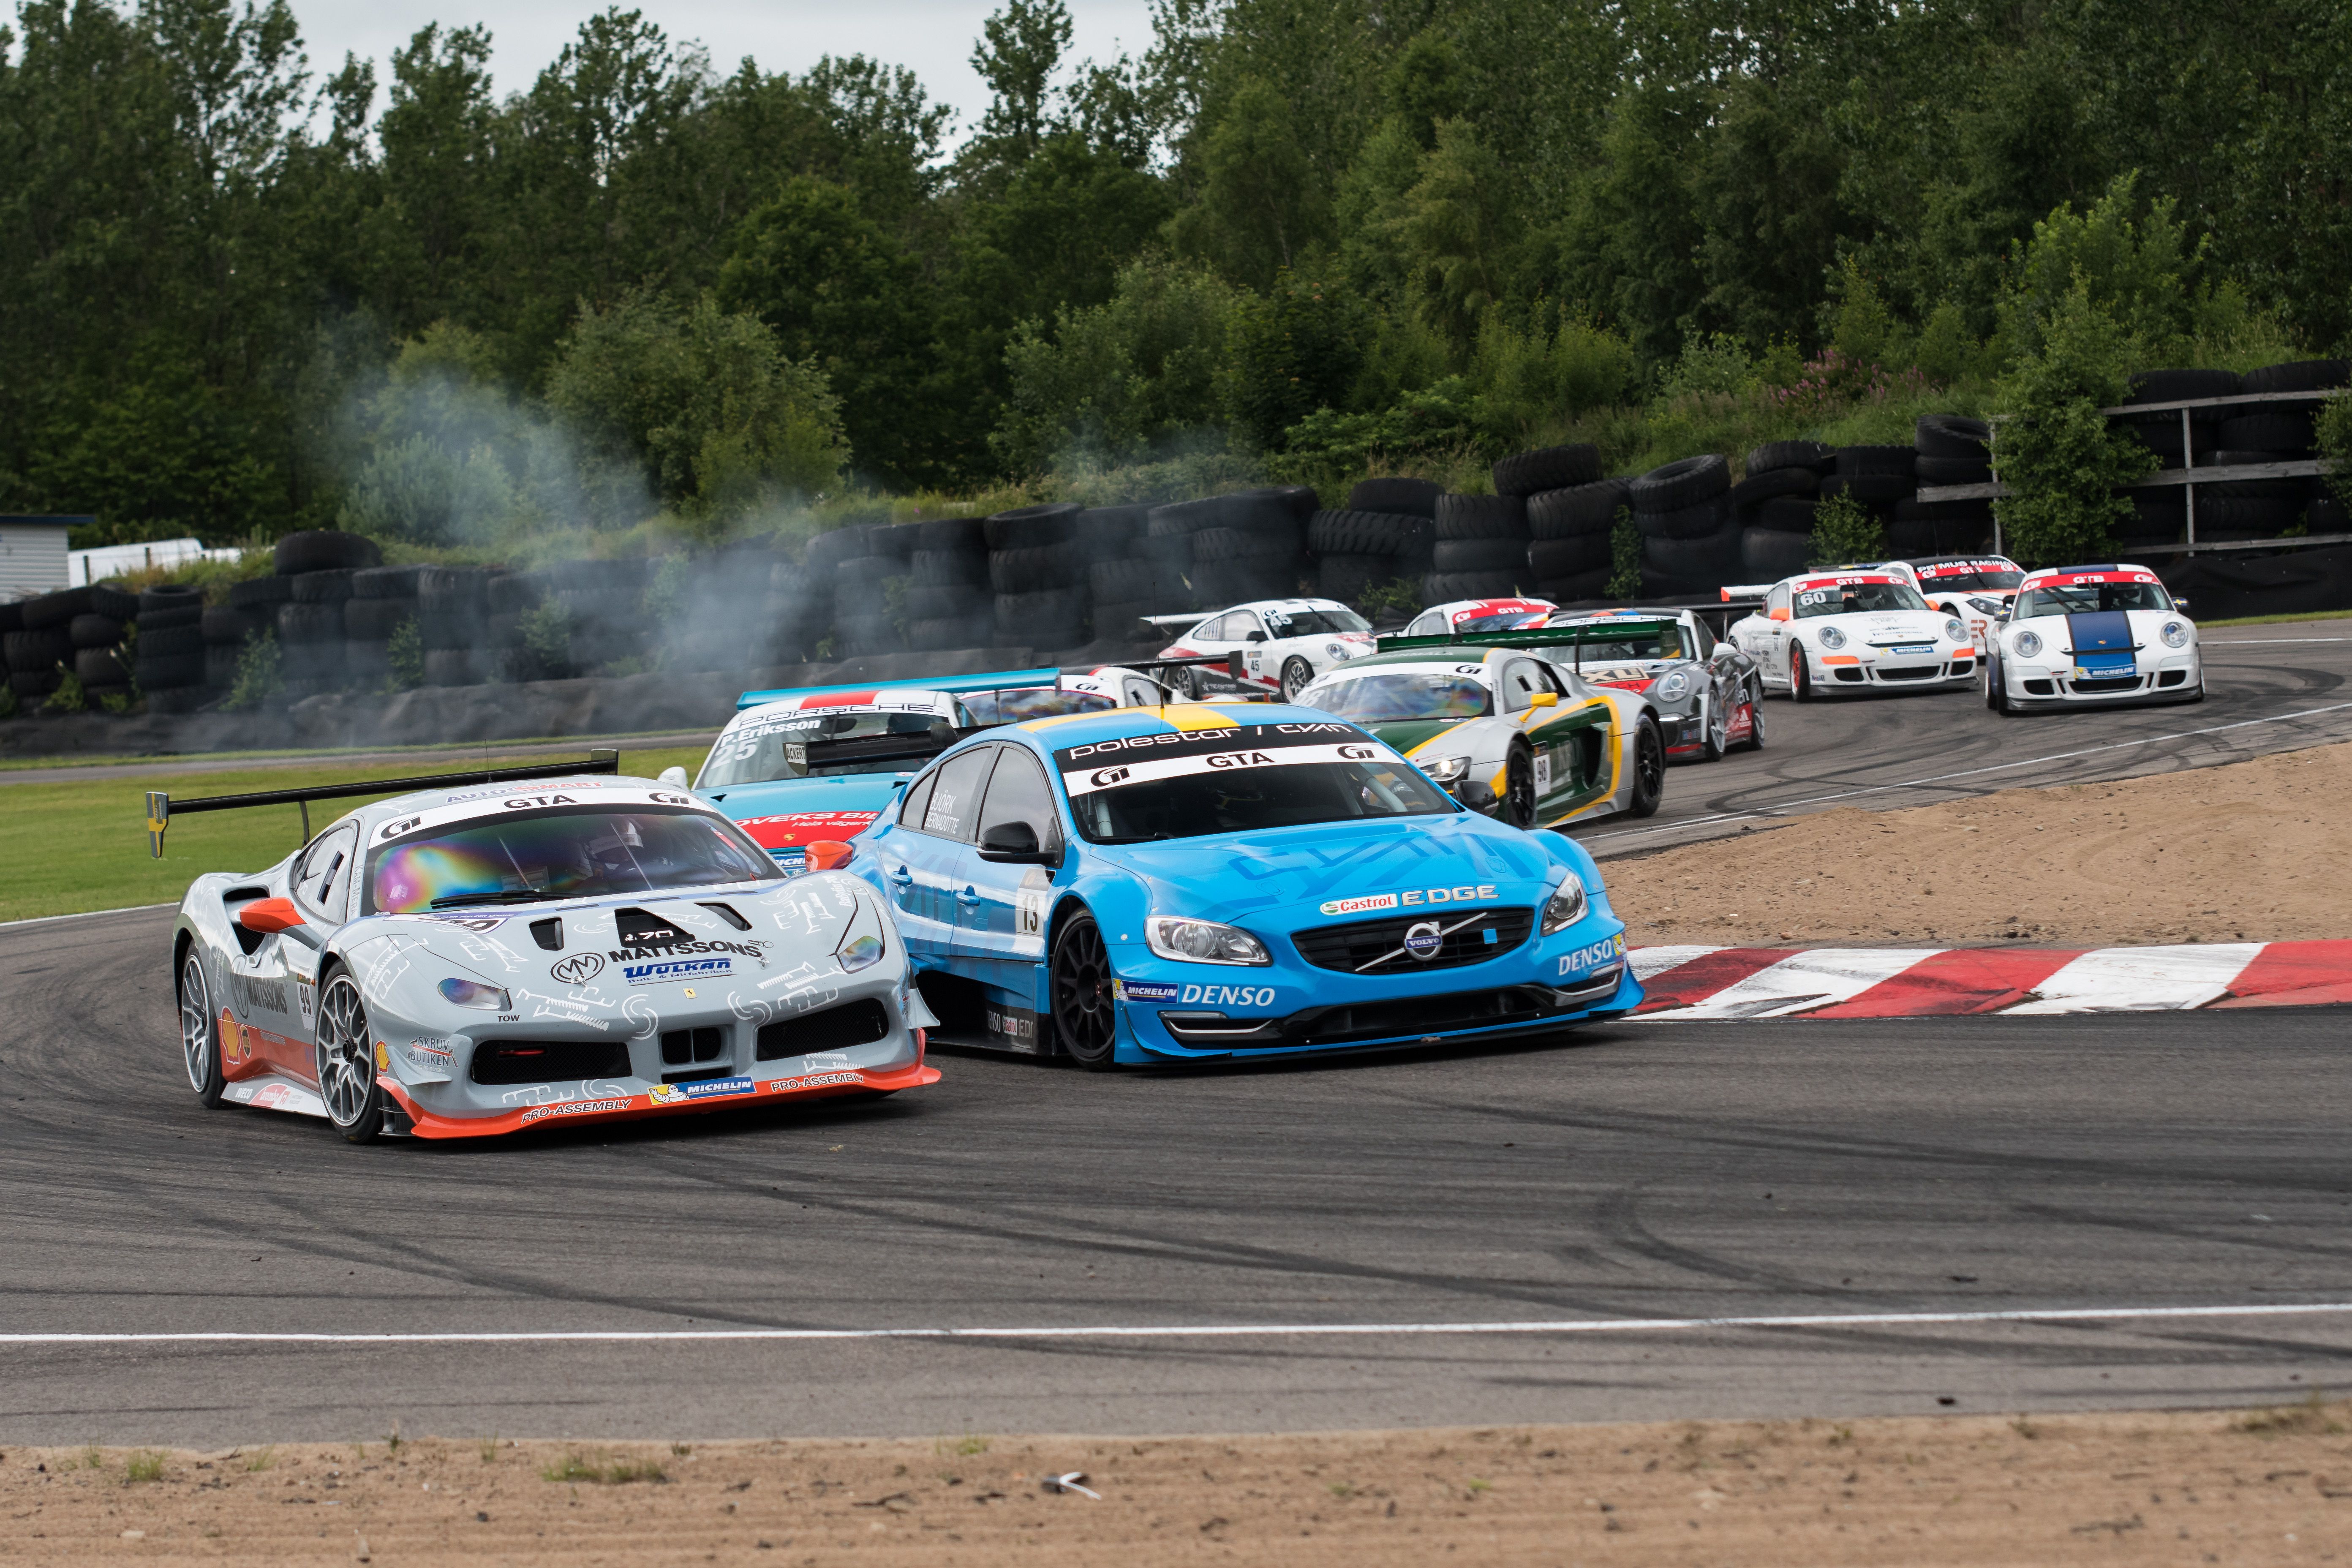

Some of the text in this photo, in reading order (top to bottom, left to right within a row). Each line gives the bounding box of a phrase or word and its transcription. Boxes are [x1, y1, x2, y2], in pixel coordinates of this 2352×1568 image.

[1836, 577, 1864, 585] GTB
[2073, 575, 2105, 583] GTB
[1800, 591, 1827, 606] 60
[1270, 614, 1293, 626] 45
[1250, 659, 1260, 672] 45
[2092, 667, 2134, 676] MICHELIN
[739, 704, 934, 727] PORSCHE
[720, 720, 821, 747] P.Eriksson
[1070, 728, 1241, 760] polestar
[710, 738, 760, 769] 25
[786, 746, 806, 761] ACKERT
[1206, 751, 1276, 768] GTA
[504, 795, 579, 808] GTA
[929, 789, 957, 814] BJÖRK
[924, 811, 960, 834] BERNADOTTE
[350, 864, 364, 916] KAM-MERA
[1340, 885, 1500, 911] Castrol EDGE
[1022, 895, 1039, 932] 13
[638, 930, 674, 940] 70
[1407, 937, 1440, 947] VOLVO
[607, 940, 763, 963] MATTSSONS
[1558, 939, 1612, 976] DENSO
[670, 969, 732, 978] Nitfabriken
[299, 984, 312, 1015] 99
[1127, 986, 1177, 996] MICHELIN
[1181, 984, 1276, 1007] DENSO
[418, 1036, 450, 1051] SKRUV
[411, 1049, 449, 1067] BUTIKEN
[687, 1080, 751, 1094] MICHELIN
[770, 1072, 865, 1092] PRO-ASSEMBLY
[234, 1087, 253, 1099] IVECO
[259, 1088, 280, 1102] brembo
[521, 1099, 632, 1124] PRO-ASSEMBLY
